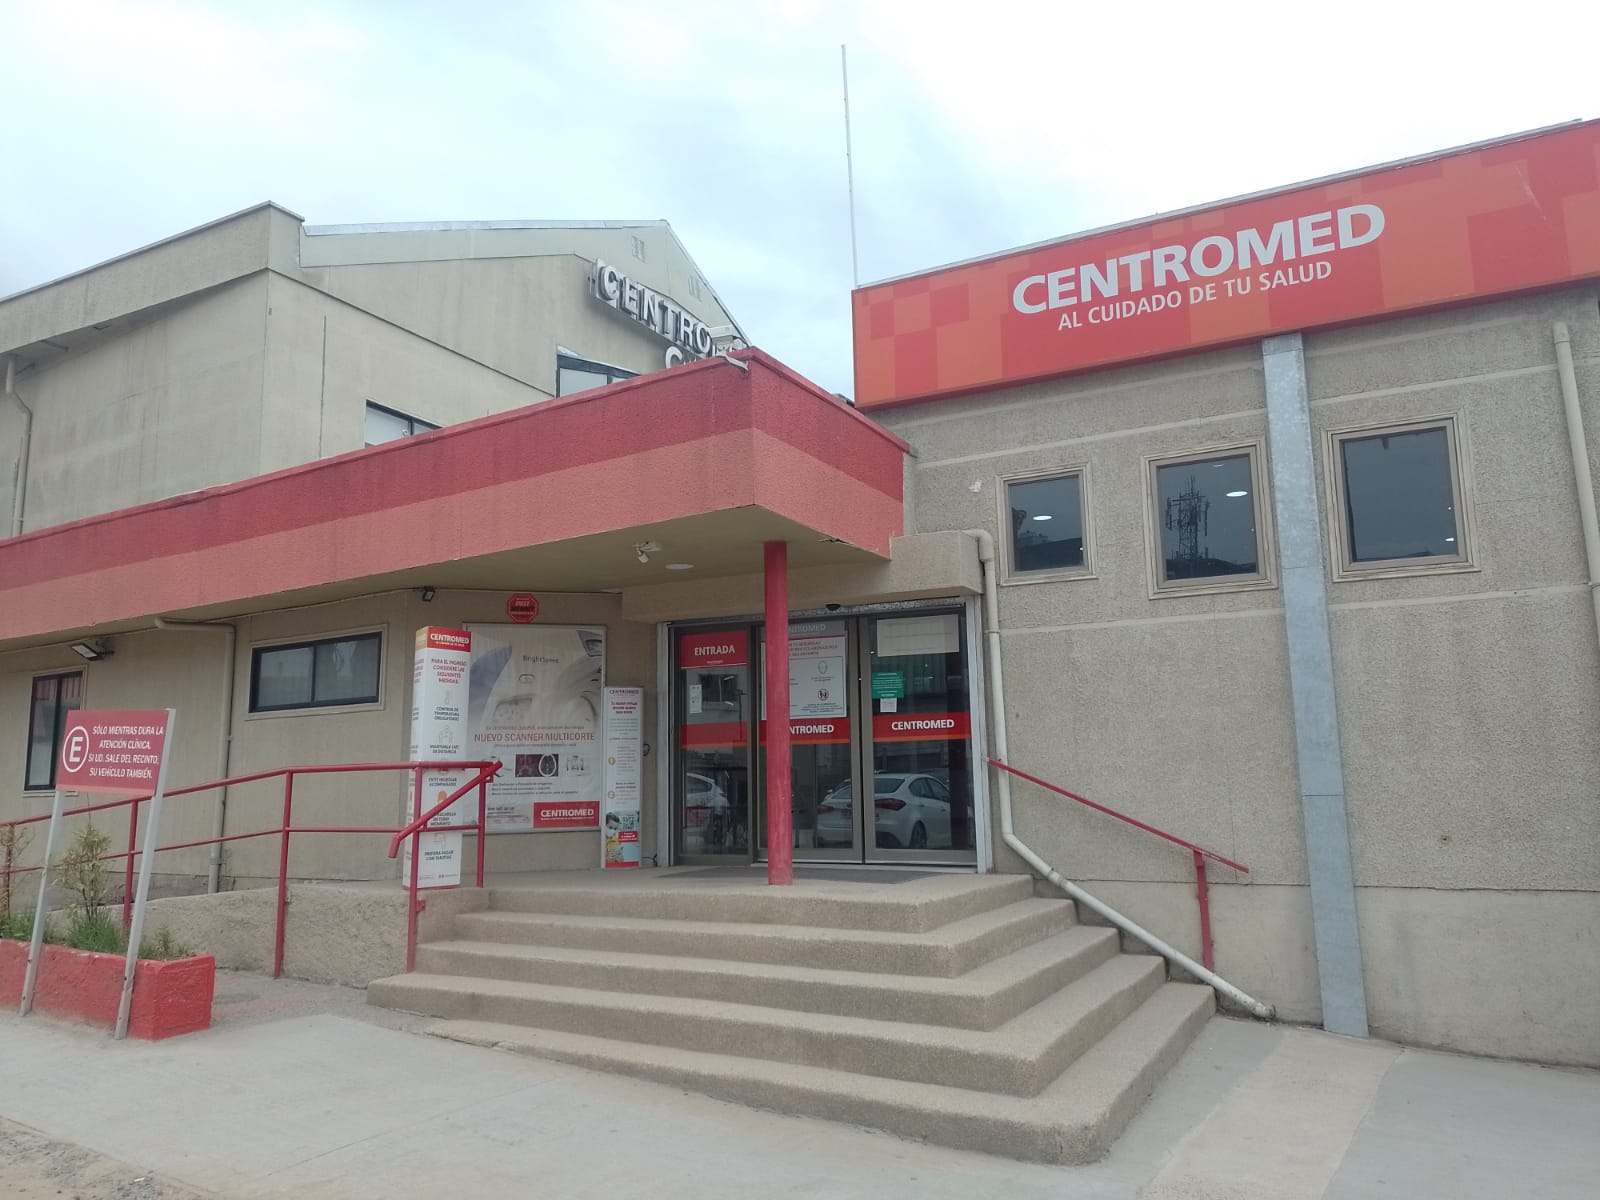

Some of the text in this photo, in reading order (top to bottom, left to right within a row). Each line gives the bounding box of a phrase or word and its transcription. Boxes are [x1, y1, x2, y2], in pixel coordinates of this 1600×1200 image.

[1013, 204, 1385, 315] CENTROMED
[1058, 261, 1332, 330] AL CUIDADO DE TU SALUD
[789, 623, 826, 633] NTROMED
[430, 633, 470, 645] CENTROMED
[694, 645, 736, 657] ENTRADA
[92, 725, 164, 736] SÓLO MIENTRAS DURA LA
[789, 724, 834, 735] NTROMED
[891, 719, 955, 731] CENTROMED
[474, 731, 596, 742] NUEVO SCANNER MULTICORTE
[99, 738, 128, 749] ATENCIÓN
[69, 736, 84, 763] E
[88, 754, 95, 763] SI
[105, 754, 121, 763] SALE
[121, 755, 132, 764] DEL
[89, 768, 98, 777] SU
[98, 766, 126, 778] VEHÍCULO
[540, 808, 595, 819] CENTROMED
